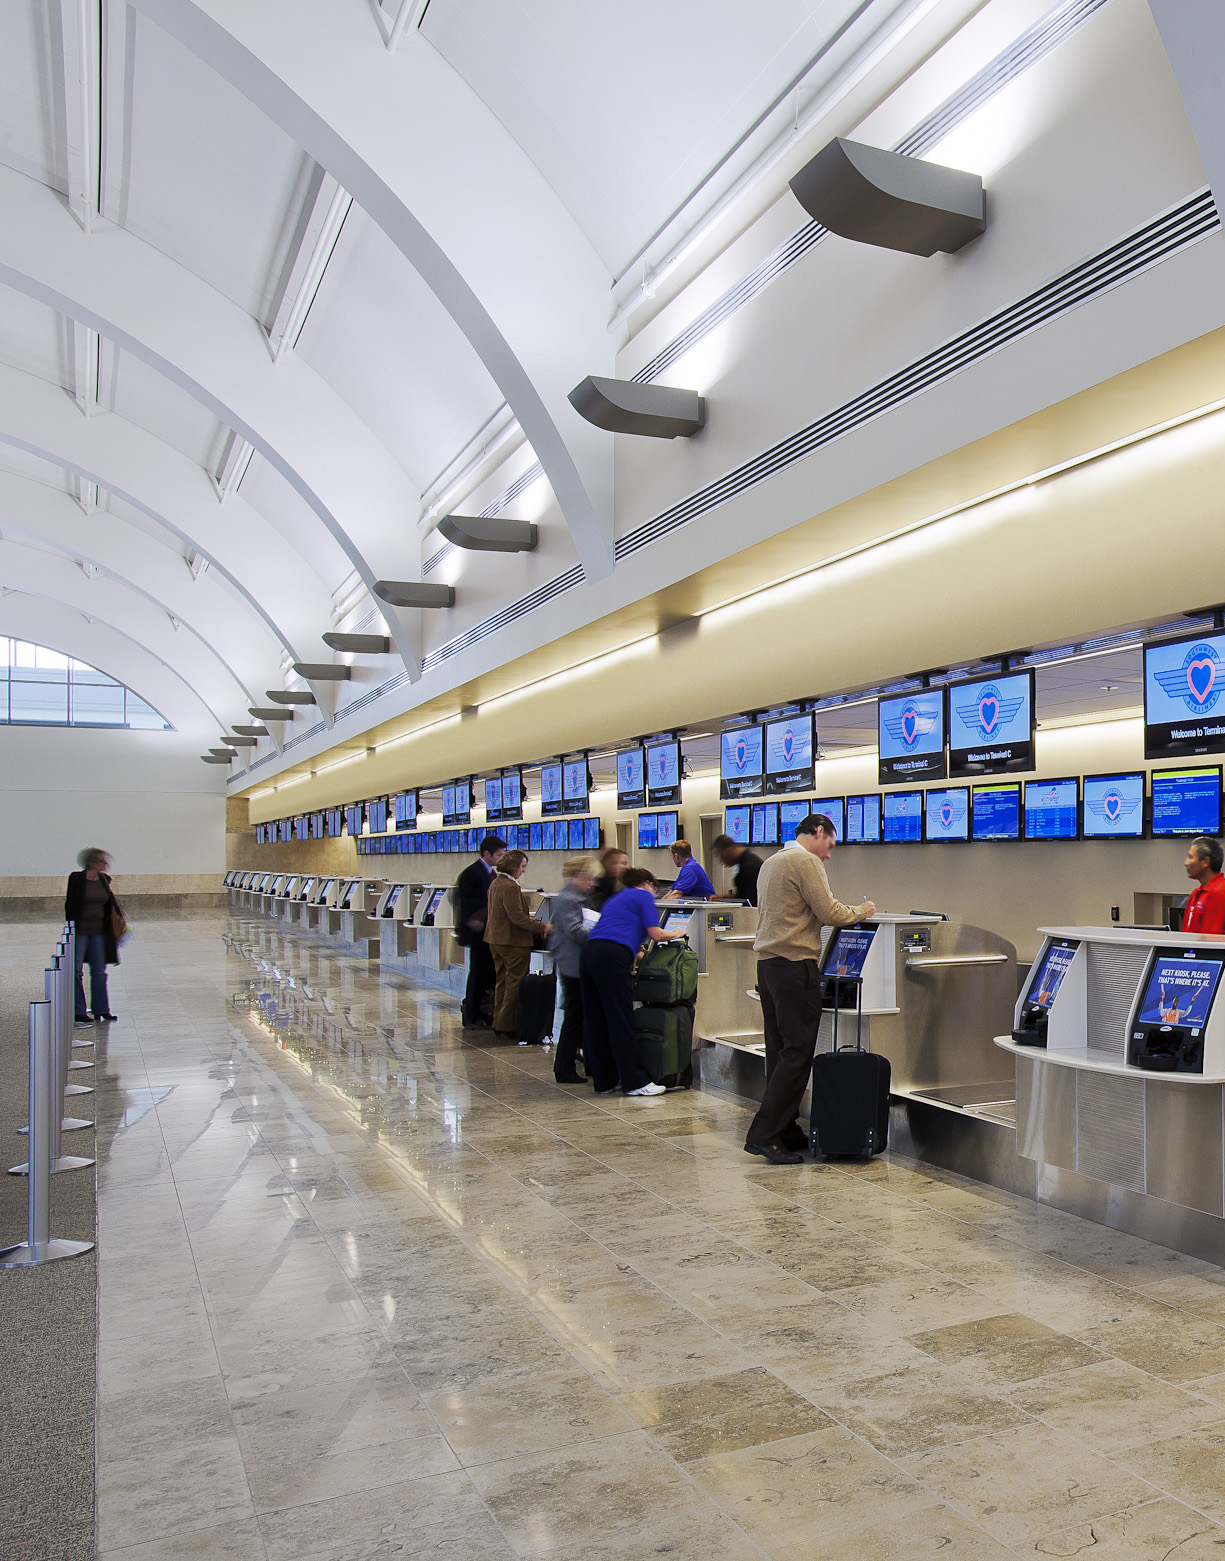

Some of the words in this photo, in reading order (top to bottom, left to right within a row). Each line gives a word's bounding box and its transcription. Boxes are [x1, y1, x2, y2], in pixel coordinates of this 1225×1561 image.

[1170, 729, 1197, 740] Welcome
[1197, 727, 1203, 737] to
[1160, 968, 1175, 977] NEXT
[1190, 970, 1211, 979] PLEASE.
[1158, 976, 1175, 984] THAT'S
[1174, 978, 1192, 986] WHERE
[1192, 979, 1202, 987] IT'S
